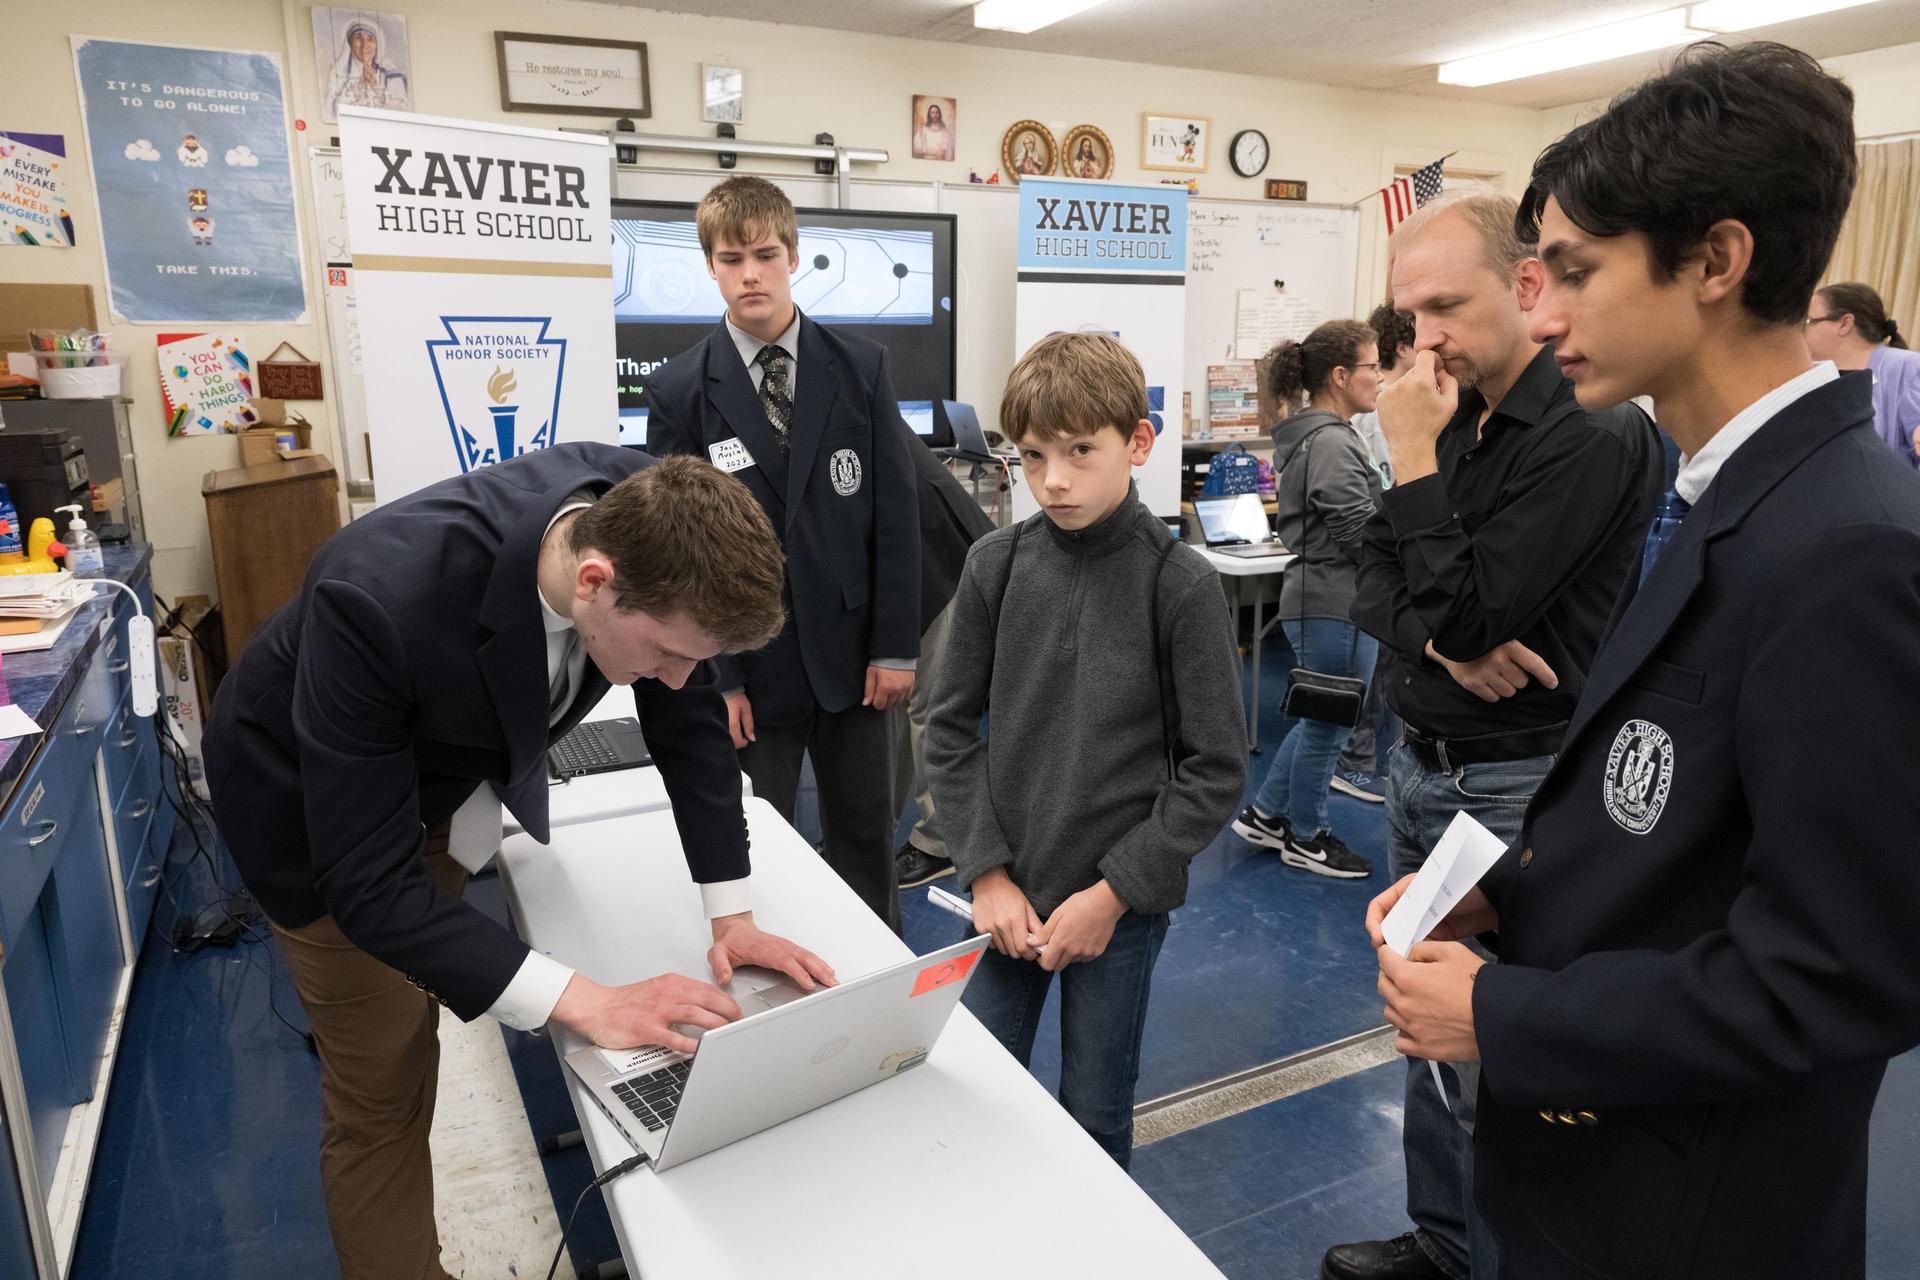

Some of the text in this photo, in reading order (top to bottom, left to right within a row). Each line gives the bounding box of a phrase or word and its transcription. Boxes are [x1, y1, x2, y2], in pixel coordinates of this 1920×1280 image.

[526, 62, 539, 73] He
[542, 65, 581, 75] restores
[584, 68, 599, 78] my
[107, 80, 260, 101] IT'S DANGEROUS
[120, 97, 246, 115] TO GO ALONE!
[1152, 134, 1178, 148] FUN
[15, 158, 51, 177] EVERY
[4, 168, 56, 192] MISTAKE
[371, 146, 590, 209] XAVIER
[16, 182, 40, 199] YOU
[0, 191, 49, 214] MAKE IS
[0, 203, 51, 226] ROGRESS
[376, 204, 466, 235] HIGH
[477, 211, 591, 242] SCHOOL
[1036, 198, 1171, 234] XAVIER
[1036, 237, 1088, 257] HIGH
[1096, 239, 1171, 259] SCHOOL
[156, 265, 258, 276] TAKE THIS.
[465, 335, 529, 346] NATIONAL
[189, 352, 216, 364] YOU
[446, 348, 549, 360] HONOR SOCIETY
[194, 362, 223, 376] CAN
[203, 374, 222, 385] DO
[199, 383, 234, 399] HARD
[198, 392, 245, 411] THINGS
[720, 442, 738, 452] Jack
[1607, 722, 1672, 805] XAVIER HIGH SCHOOL
